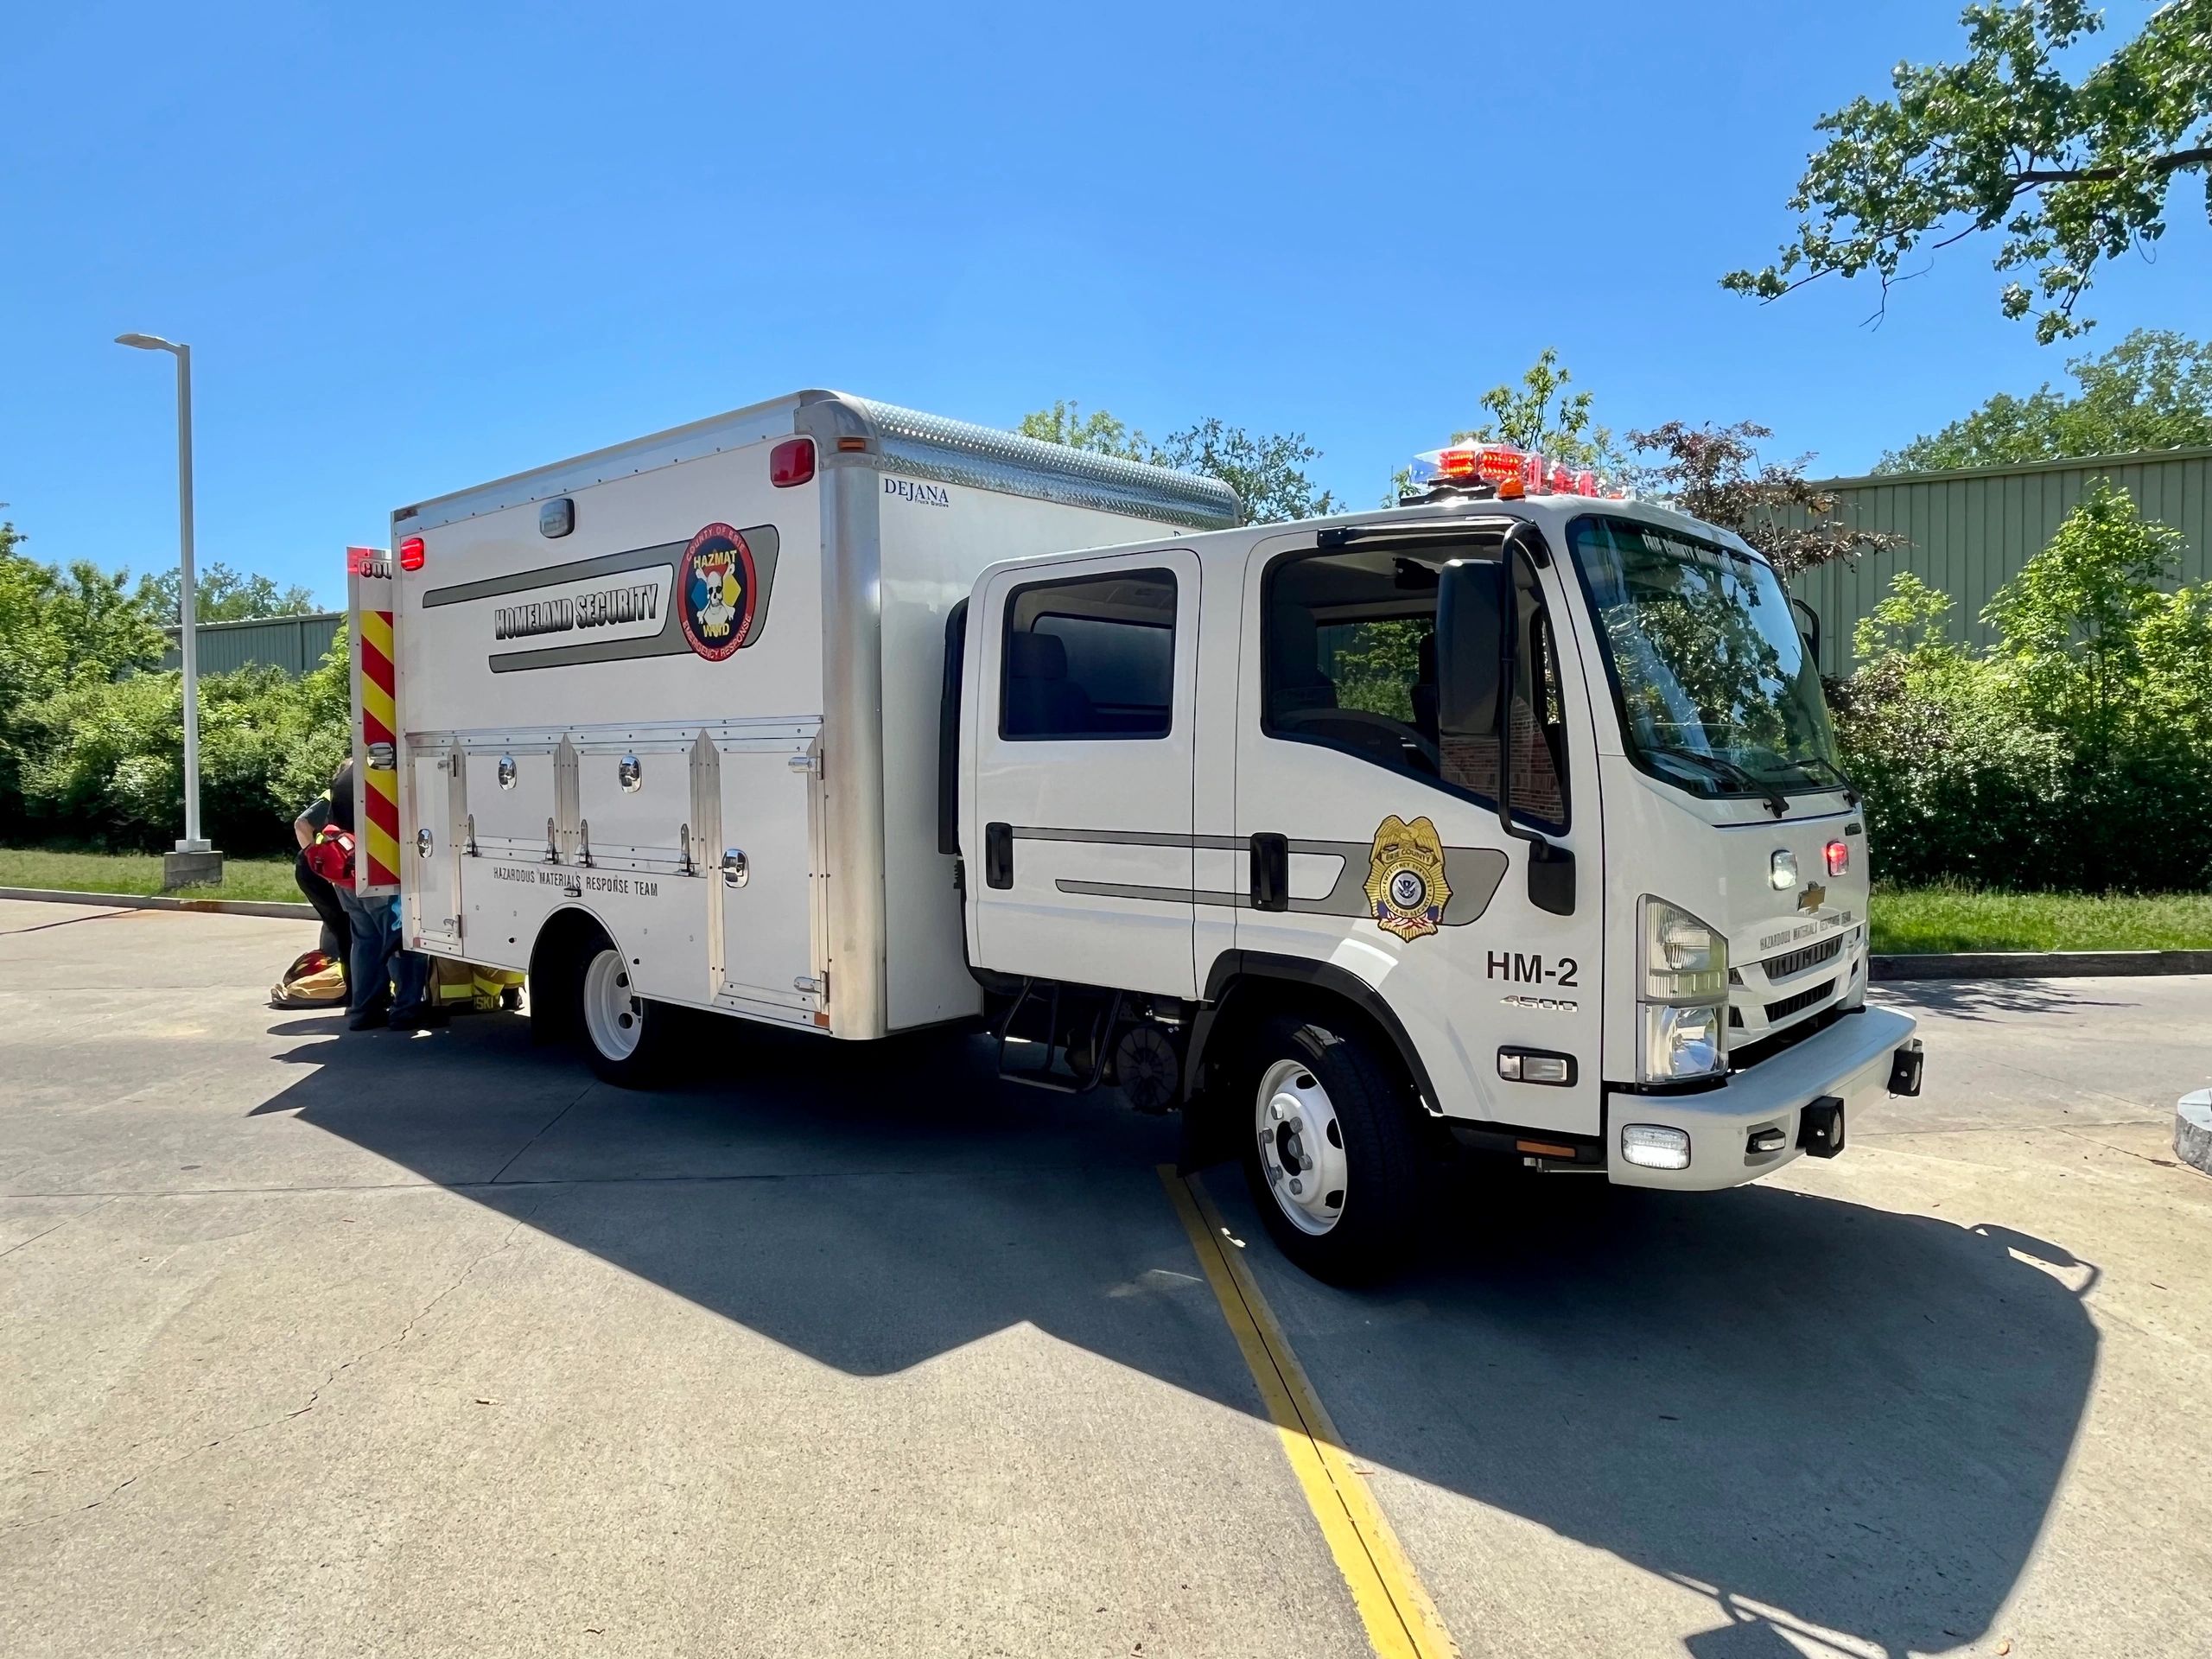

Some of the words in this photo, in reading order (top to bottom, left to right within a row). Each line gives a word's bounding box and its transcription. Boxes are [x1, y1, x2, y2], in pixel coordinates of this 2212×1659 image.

[884, 478, 949, 503] DEJANA
[686, 527, 714, 562] COUNTY
[715, 526, 727, 537] OF
[728, 529, 745, 552] ERIE
[693, 550, 737, 569] HAZMAT
[494, 598, 574, 640] HOMELAND
[575, 583, 658, 629] SECURITY
[682, 620, 719, 659] EMERGENCY
[720, 614, 752, 658] RESPONSE
[1401, 849, 1431, 863] COUNTY
[493, 867, 536, 884] HAZARDOUS
[539, 871, 582, 890] MATERIALS
[586, 875, 629, 894] RESPONSE
[634, 880, 658, 897] TEAM
[1487, 950, 1579, 988] HM-2
[1499, 995, 1580, 1013] 4500
